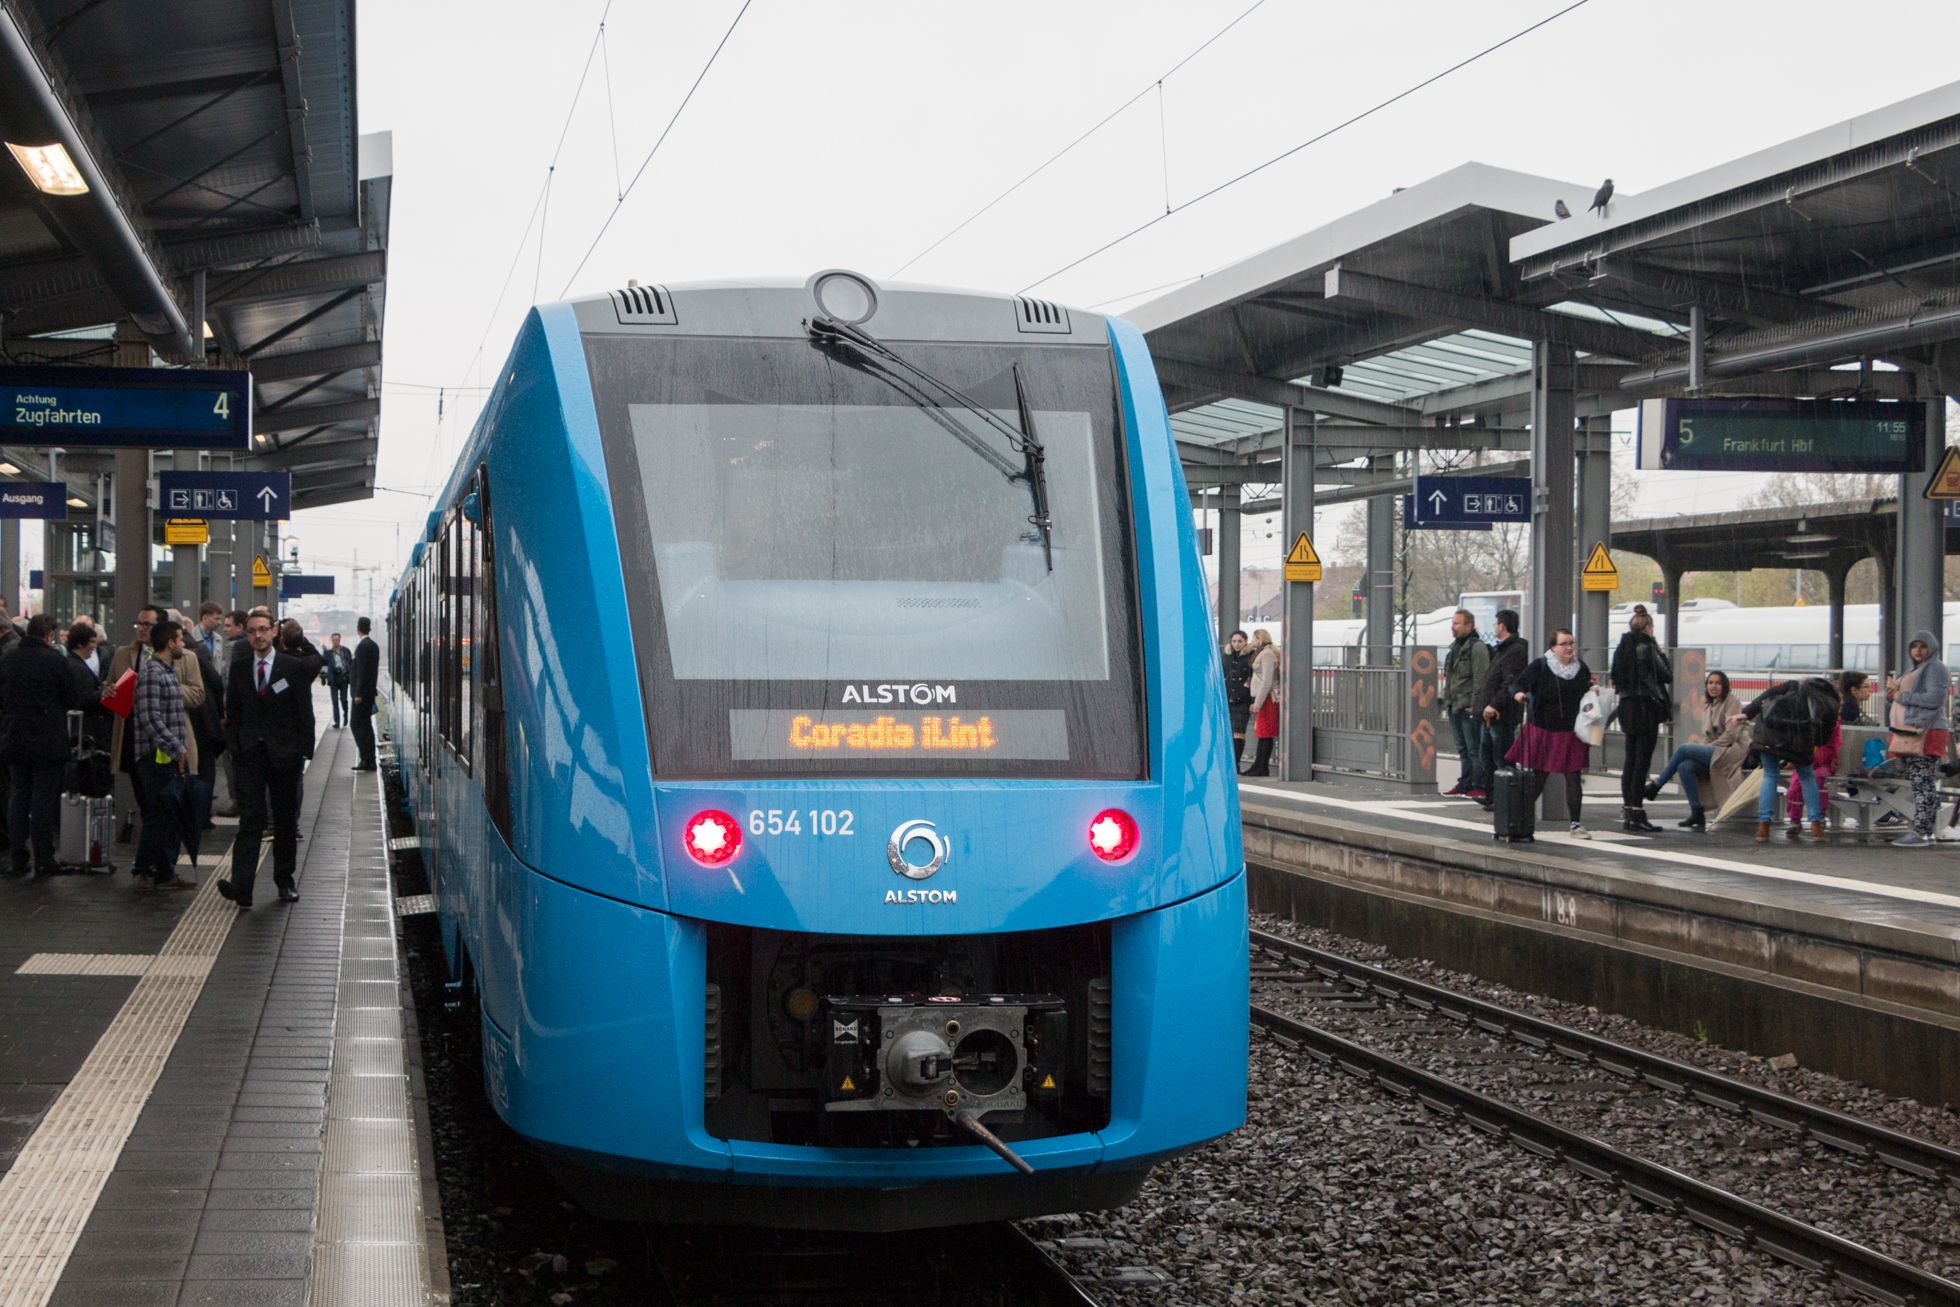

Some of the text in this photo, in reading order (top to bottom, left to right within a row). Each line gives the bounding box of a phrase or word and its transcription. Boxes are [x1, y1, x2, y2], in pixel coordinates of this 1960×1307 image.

[16, 394, 57, 407] Achtung
[213, 391, 230, 420] 4
[15, 407, 102, 427] Zugfahrten
[1876, 421, 1907, 433] 11:55
[1678, 418, 1695, 444] 5
[1722, 437, 1815, 452] Frankfurt Hbf
[2, 493, 44, 505] Ausgang
[841, 683, 957, 705] ALSTOM
[791, 715, 996, 748] Coradia iLint
[750, 809, 854, 836] 654 102
[884, 889, 957, 905] ALSTOM
